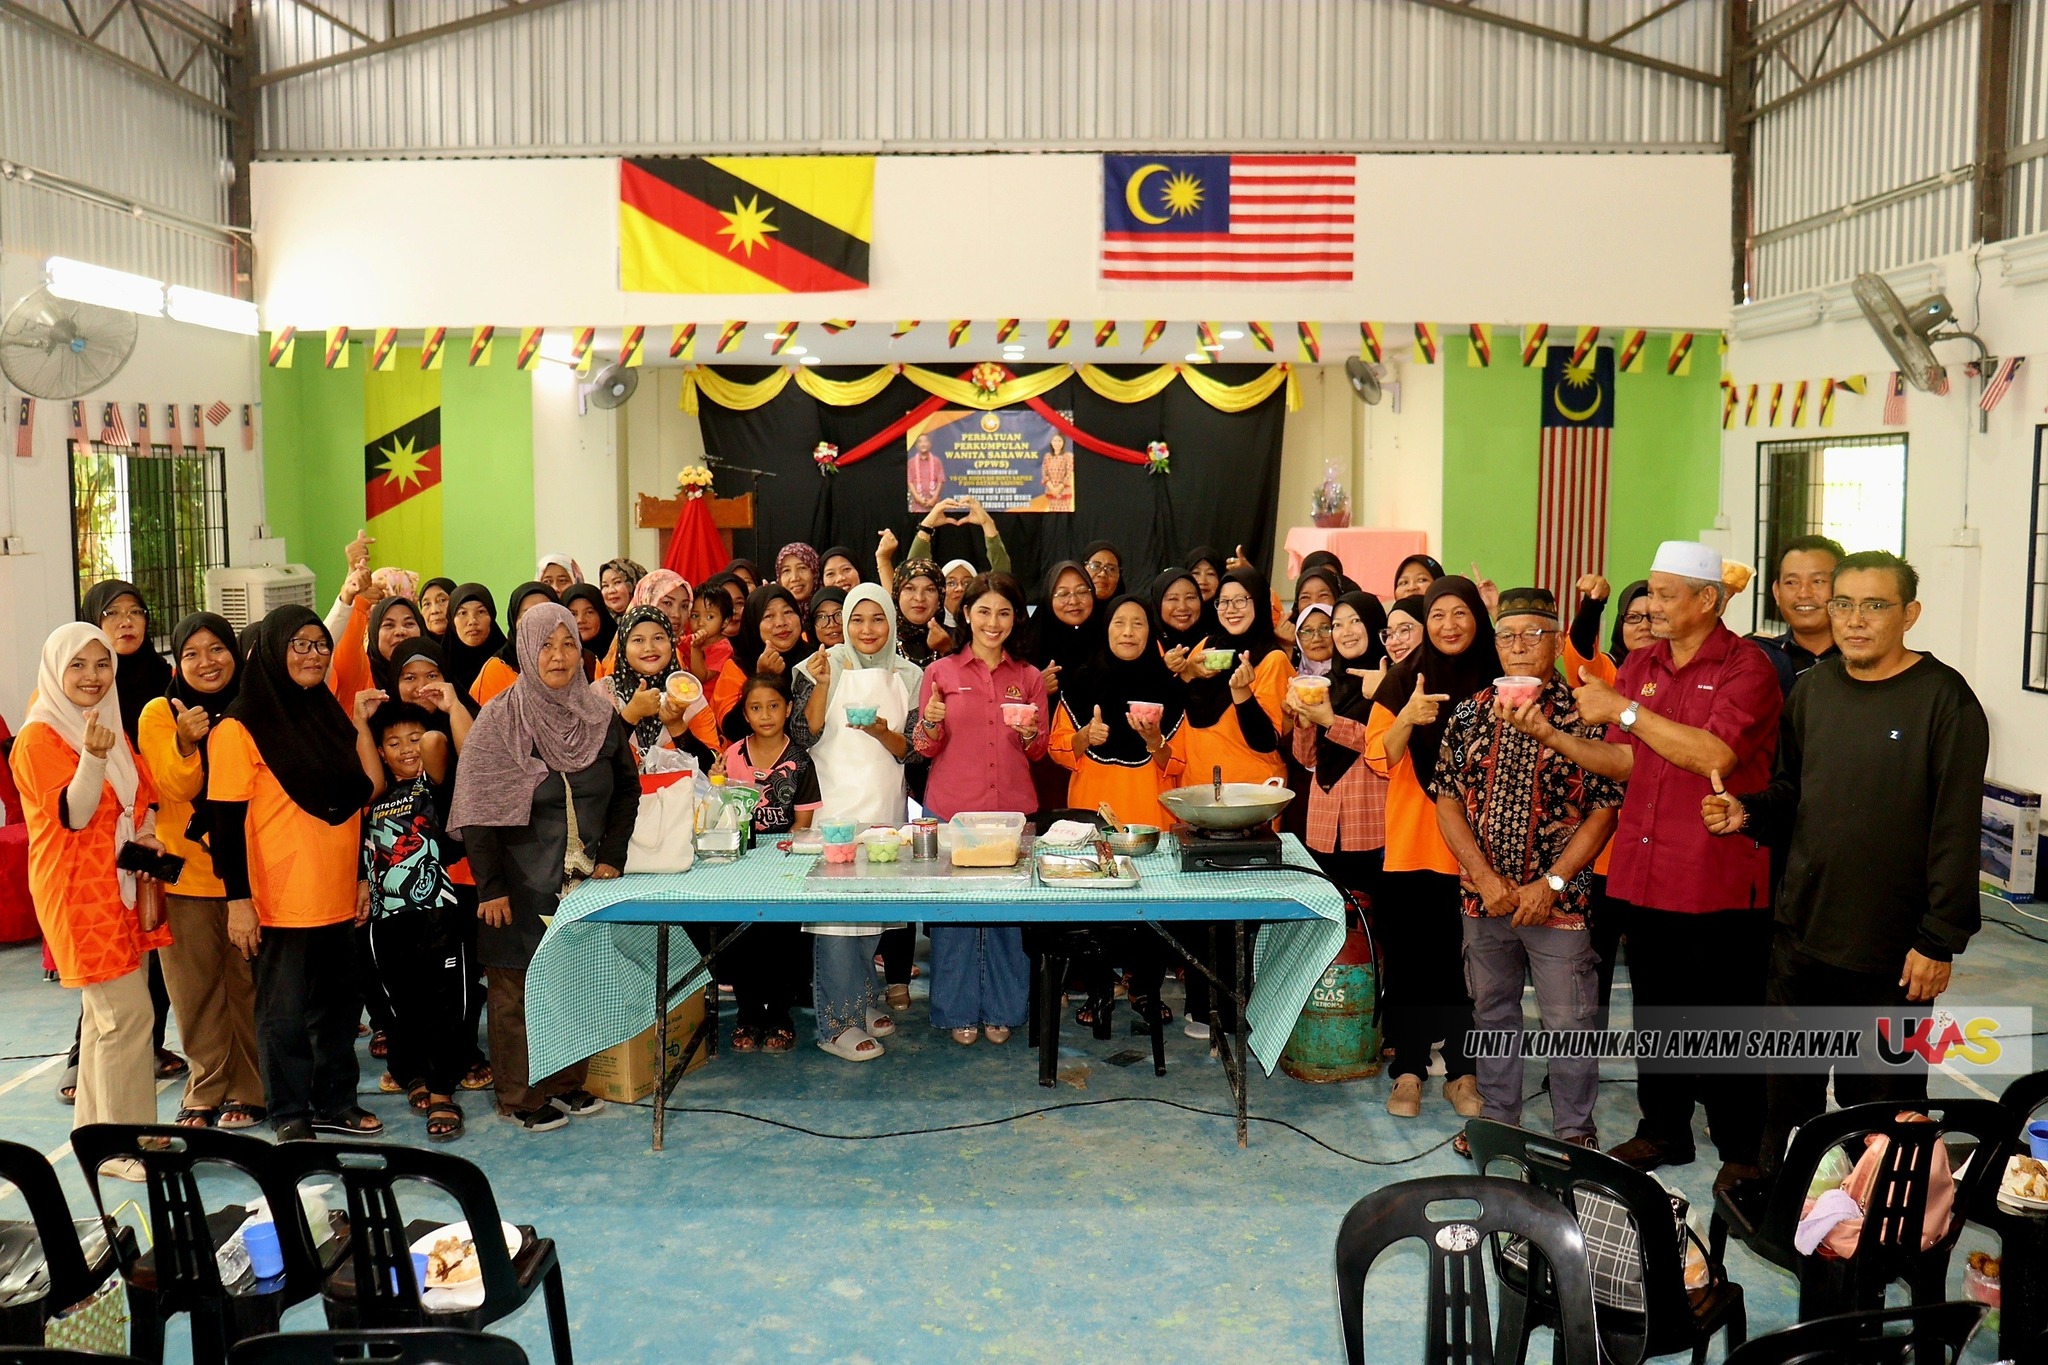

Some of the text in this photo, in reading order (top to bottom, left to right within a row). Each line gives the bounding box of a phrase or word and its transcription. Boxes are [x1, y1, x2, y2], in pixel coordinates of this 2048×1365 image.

[962, 433, 1021, 441] PERSATUAN
[954, 442, 1029, 450] PERKUMPULAN
[945, 451, 1038, 459] WANITA SARAWAK
[974, 460, 1009, 469] (PPWS)
[1313, 988, 1345, 1003] GAS
